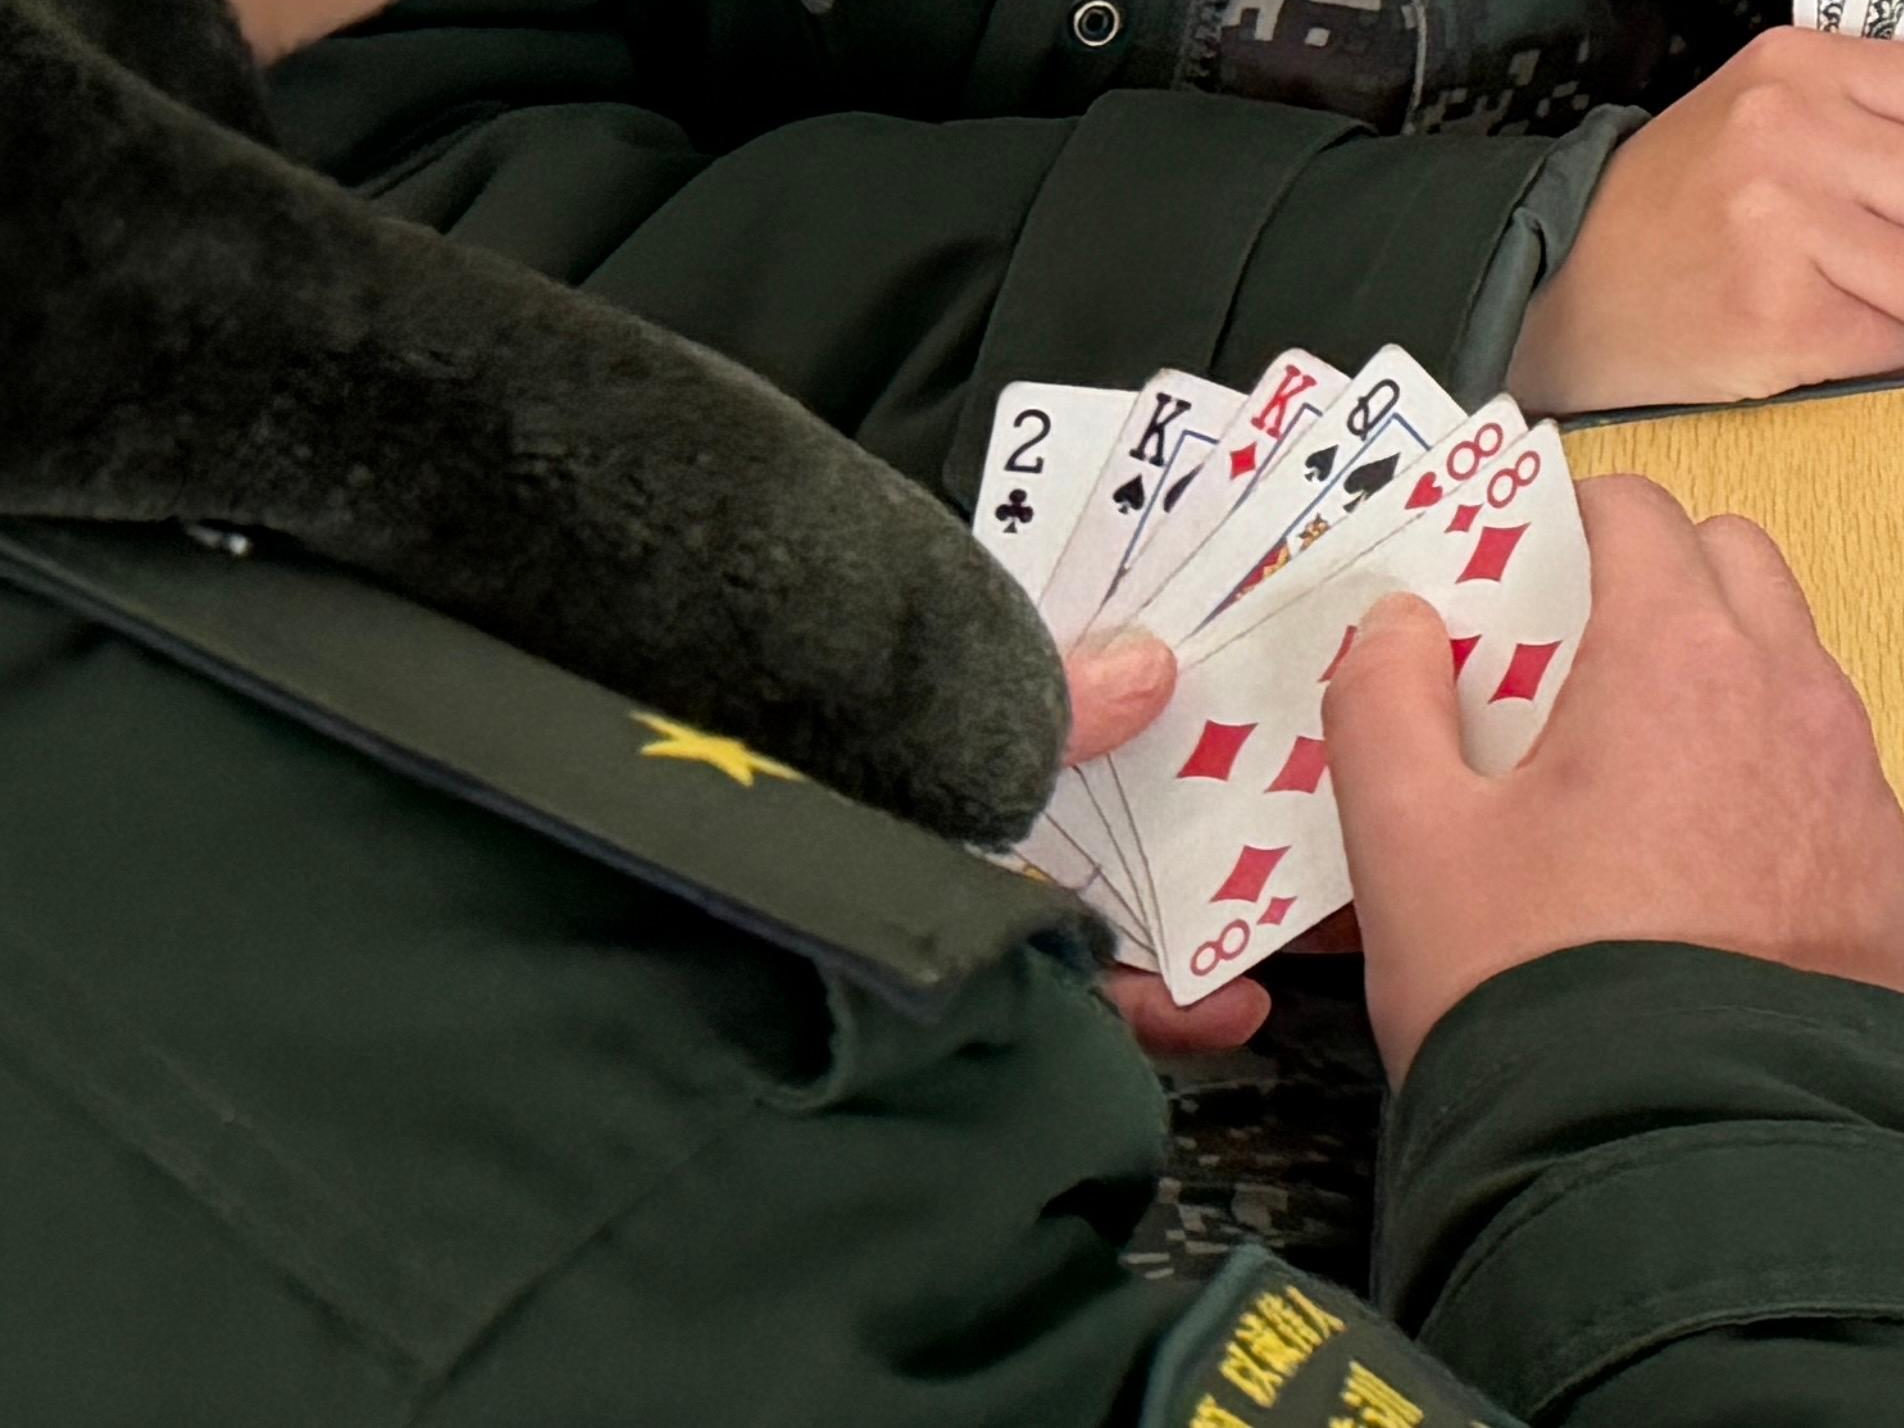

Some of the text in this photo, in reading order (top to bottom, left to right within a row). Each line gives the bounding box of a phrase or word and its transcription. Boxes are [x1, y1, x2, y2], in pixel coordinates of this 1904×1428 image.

[1129, 392, 1192, 468] K
[1251, 364, 1317, 437] K
[1346, 378, 1401, 443] Q
[1003, 408, 1052, 475] 2
[1446, 422, 1504, 482] 8
[1486, 450, 1541, 509] 8
[1189, 918, 1251, 977] 8
